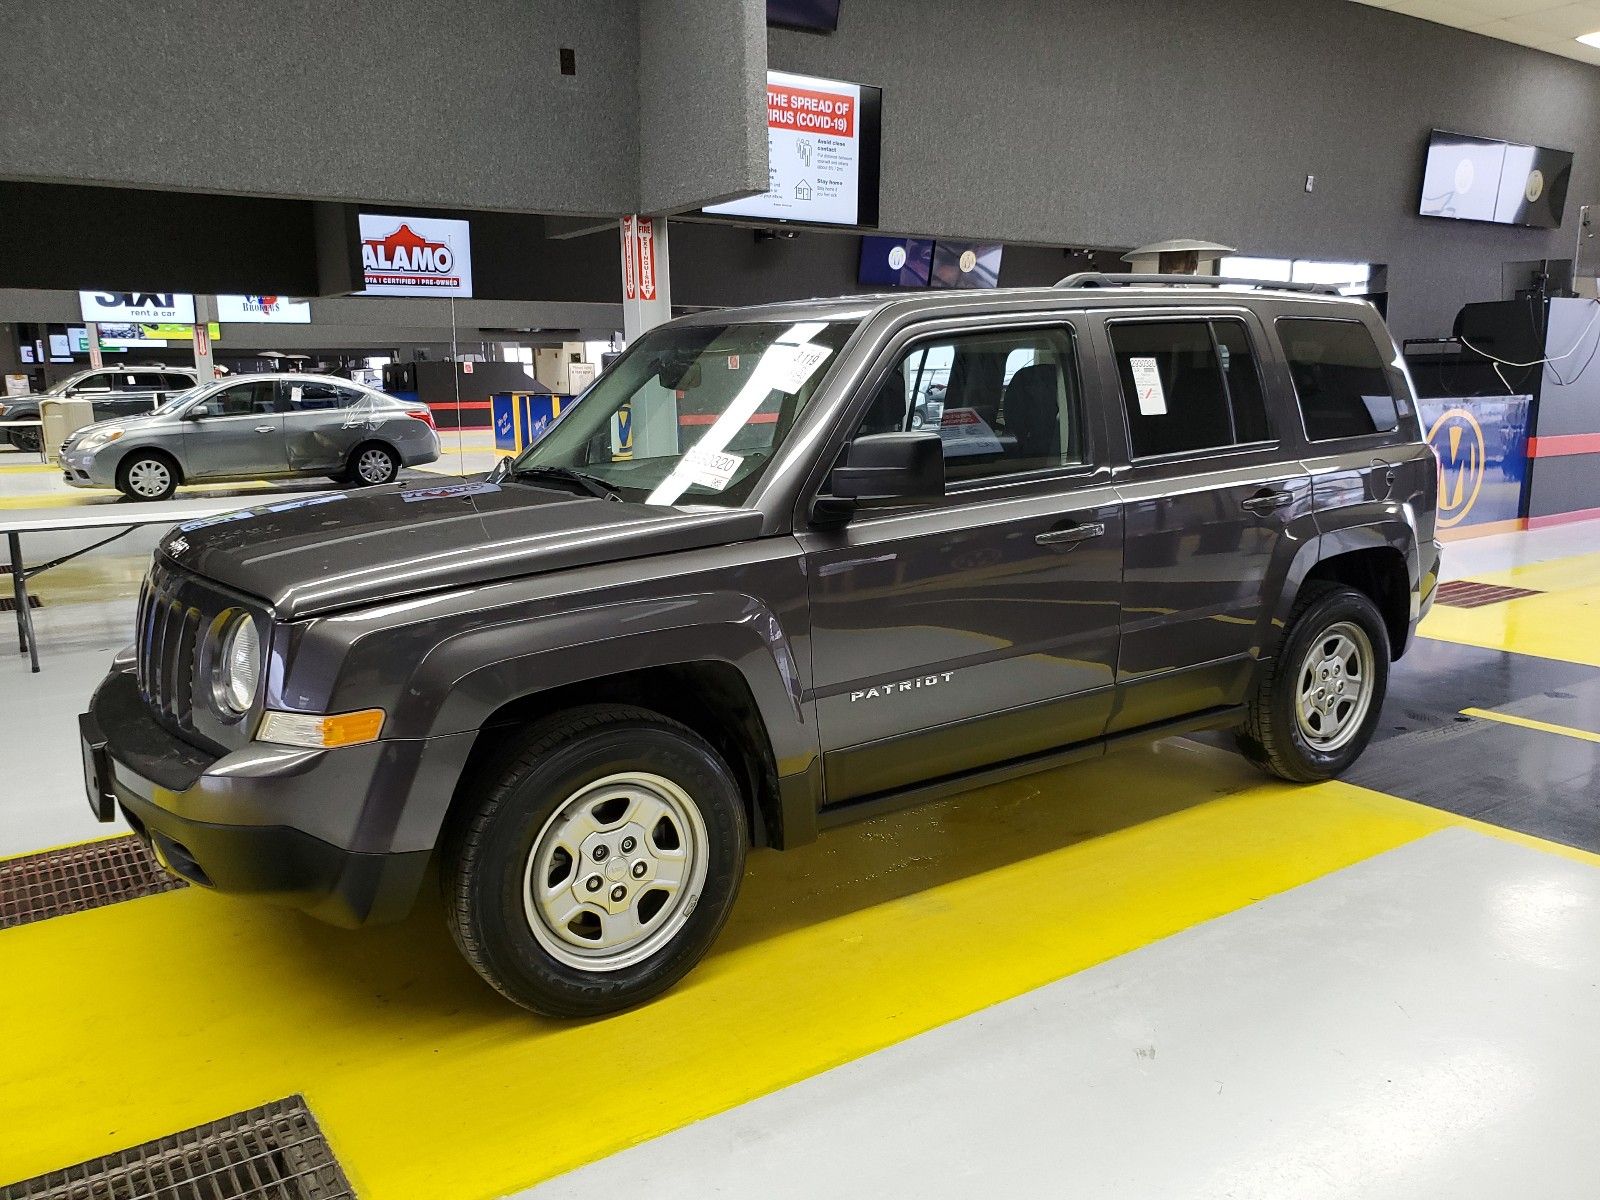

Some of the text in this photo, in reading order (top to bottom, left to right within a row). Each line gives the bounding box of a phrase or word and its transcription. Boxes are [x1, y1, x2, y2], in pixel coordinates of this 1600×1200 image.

[767, 92, 849, 115] THE SPREAD OF
[767, 108, 847, 132] IRUS (COVID-19)
[638, 226, 651, 234] FIRE
[361, 244, 453, 273] ALAMO
[382, 277, 416, 285] CERTIFIED
[131, 309, 151, 317] rent
[849, 671, 954, 702] PATRIOT
